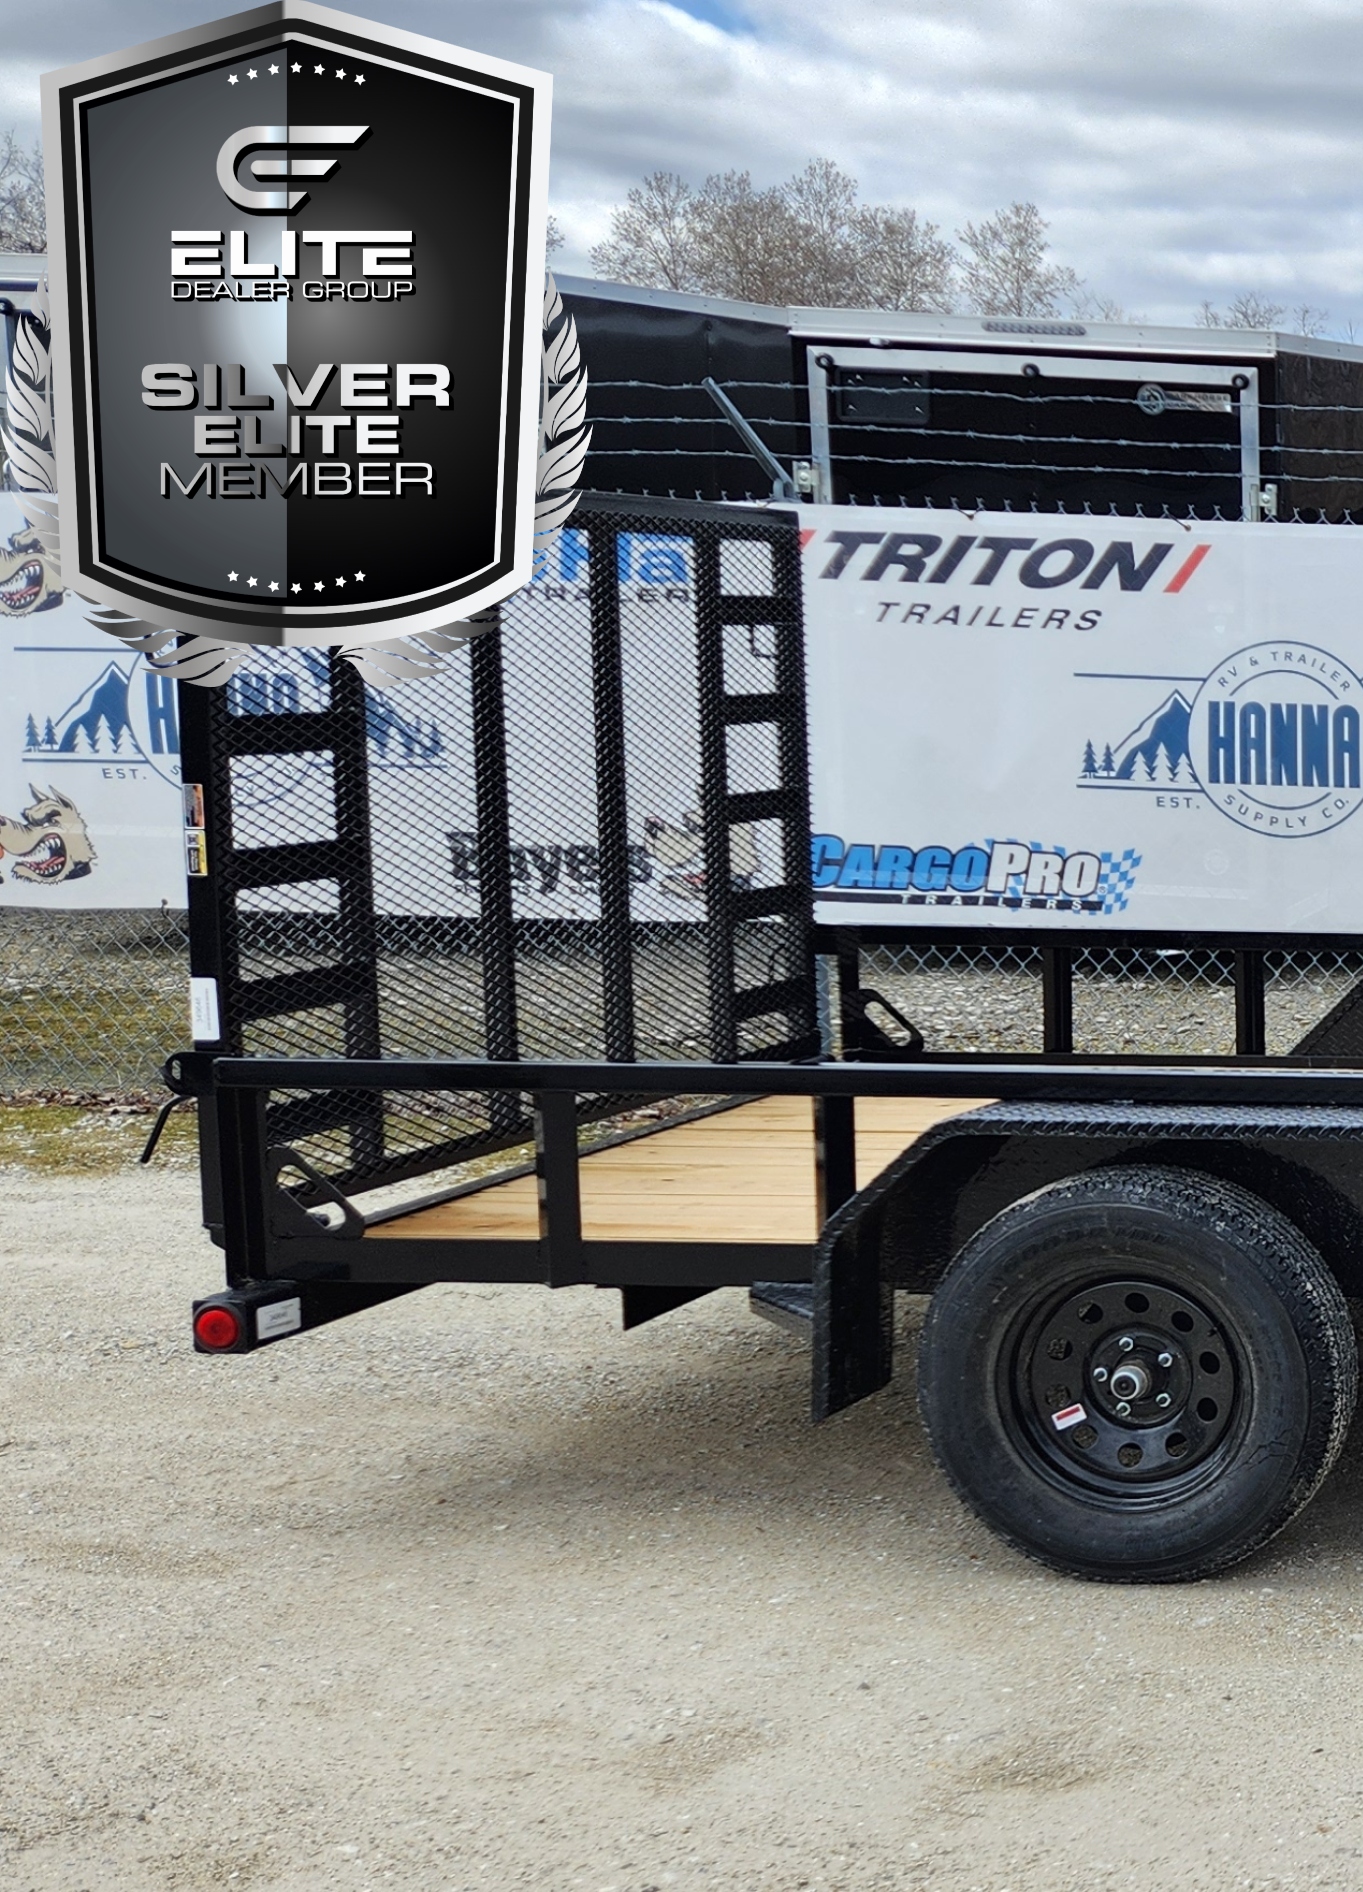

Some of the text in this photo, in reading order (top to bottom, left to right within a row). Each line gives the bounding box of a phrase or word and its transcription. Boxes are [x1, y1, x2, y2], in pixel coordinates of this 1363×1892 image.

[819, 531, 1174, 593] TRITON
[875, 602, 1103, 632] TRAILERS
[1217, 651, 1352, 693] RV & TRAILER
[1207, 701, 1361, 789] HANNA
[102, 767, 147, 781] EST.
[1156, 795, 1202, 811] EST.
[1223, 793, 1309, 830] SUPPLY
[1321, 796, 1352, 822] CO.
[901, 894, 1085, 912] TRAILERS
